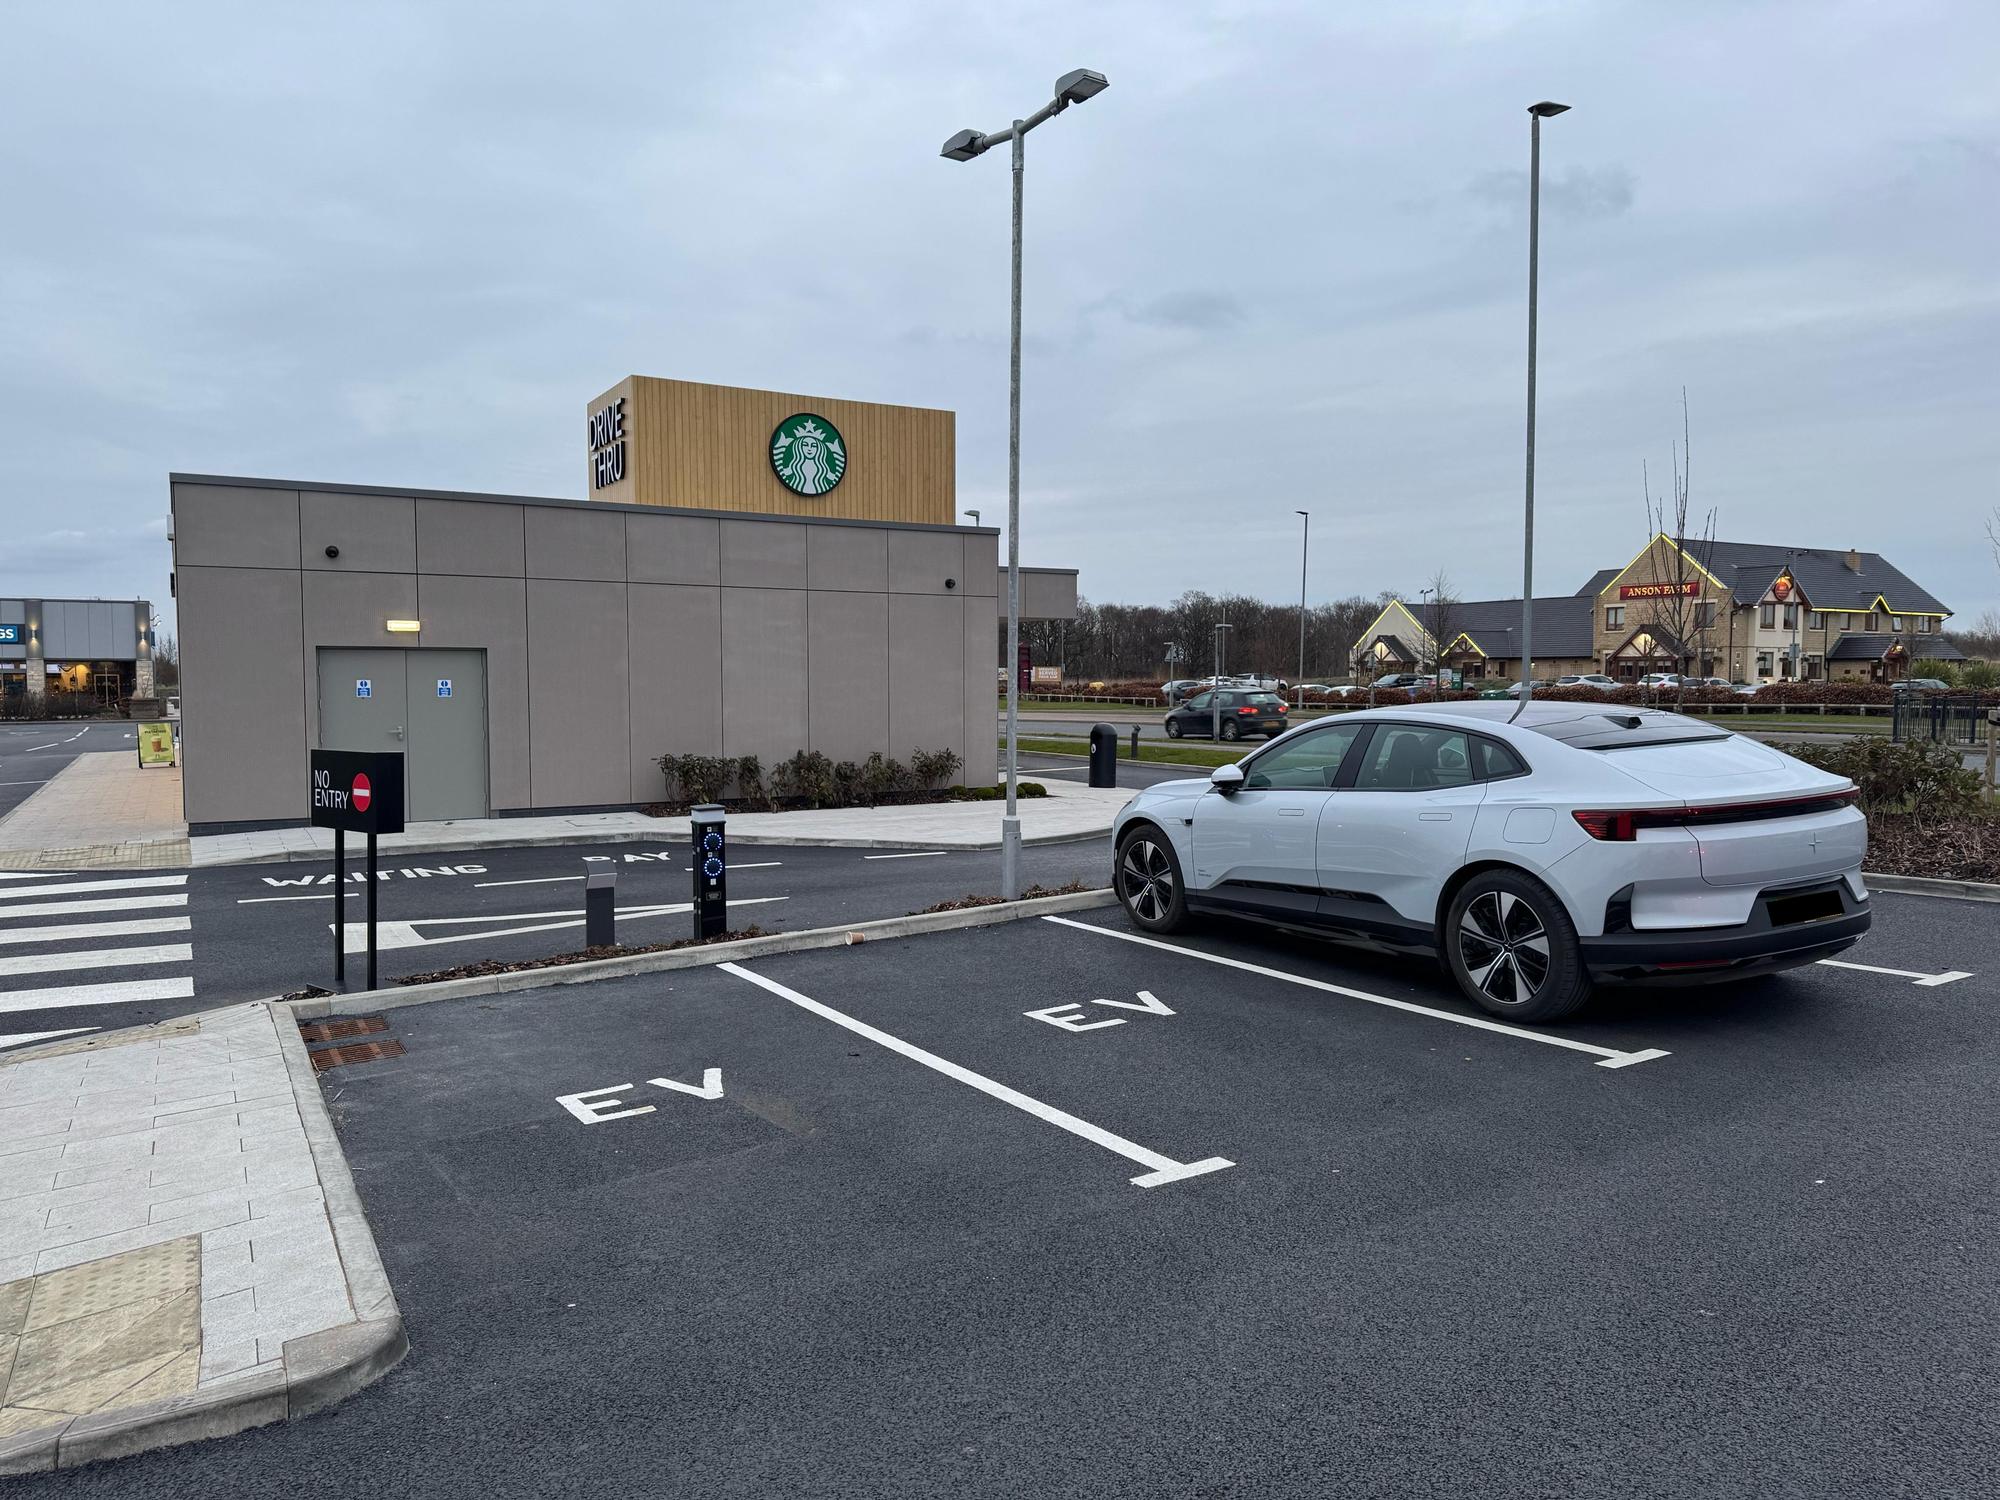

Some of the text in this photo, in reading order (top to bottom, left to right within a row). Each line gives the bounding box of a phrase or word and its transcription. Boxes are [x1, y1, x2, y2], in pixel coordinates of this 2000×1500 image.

[589, 398, 624, 451] DRIVE
[591, 440, 625, 490] THRU
[1627, 586, 1662, 597] ANSON
[314, 769, 330, 789] NO
[314, 788, 350, 810] ENTRY
[261, 864, 488, 887] WAITING
[1022, 990, 1177, 1033] EV
[555, 1067, 724, 1126] EV
